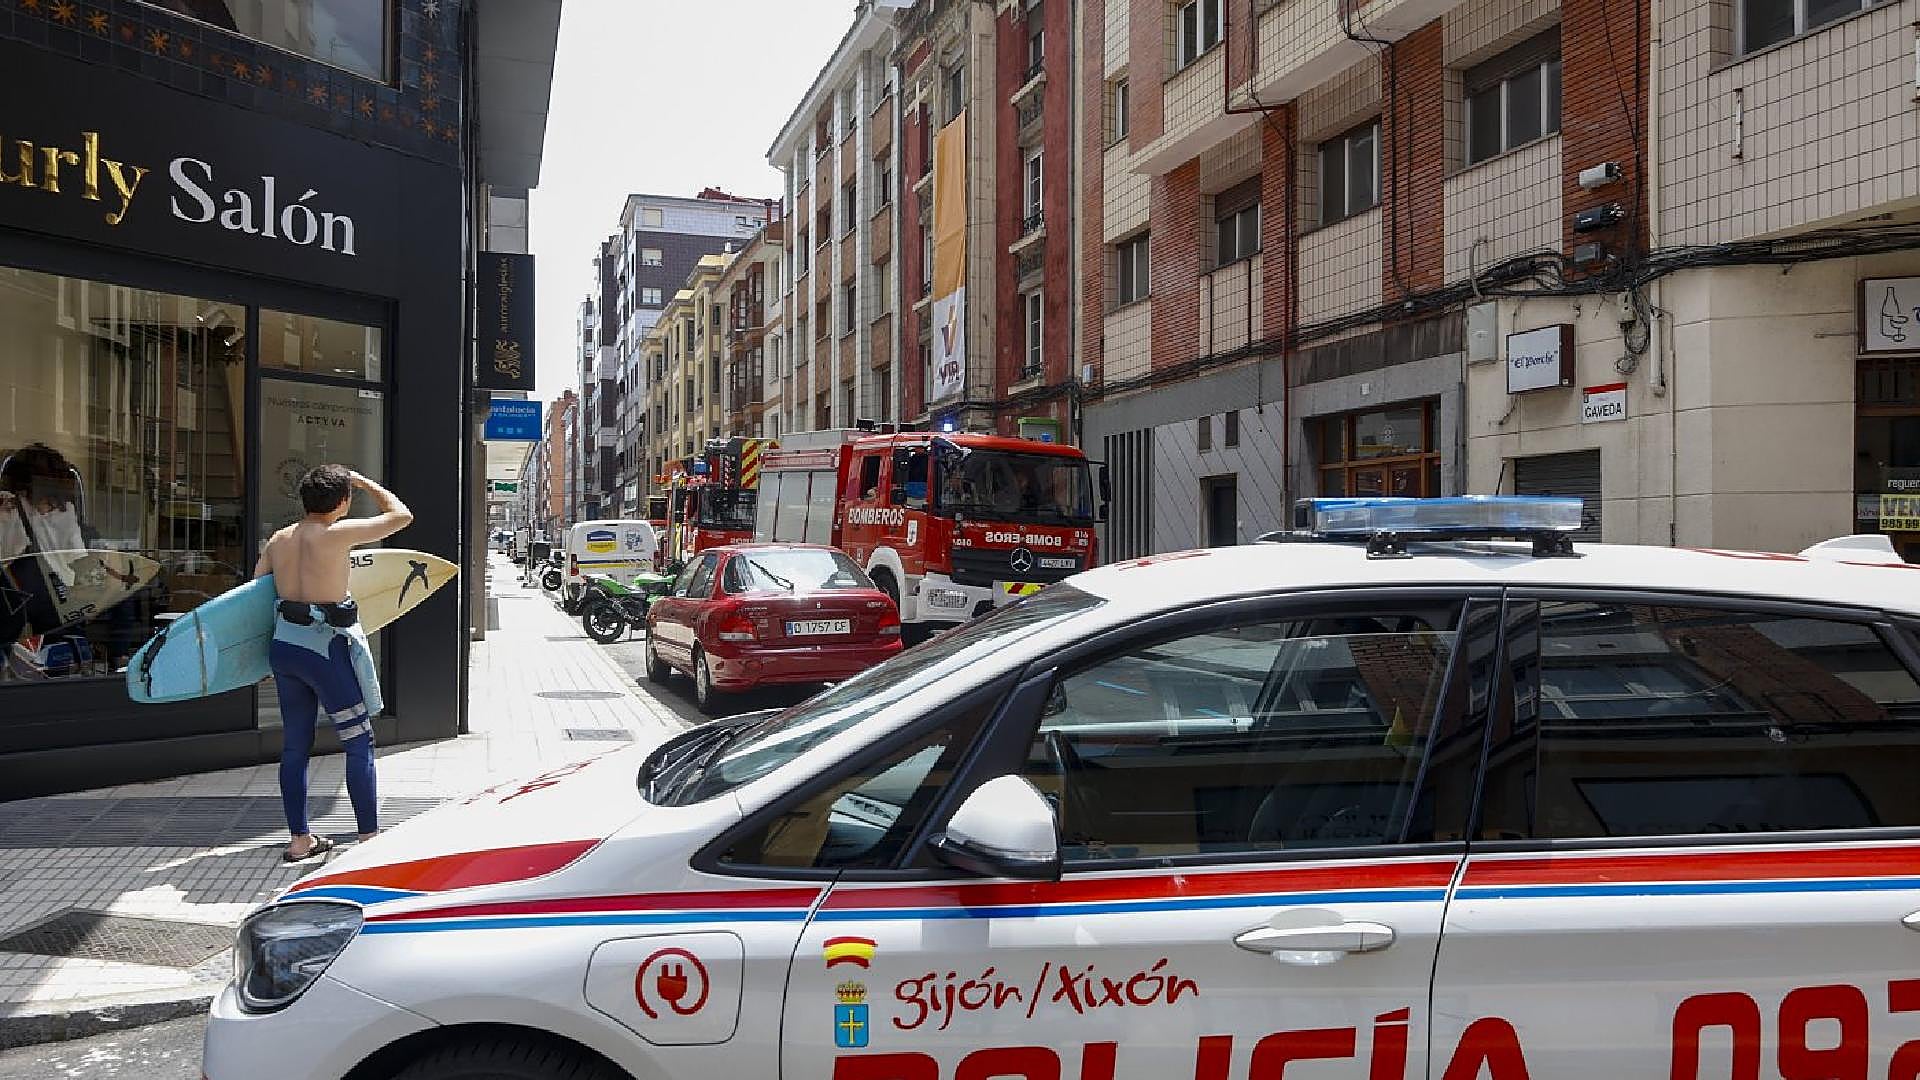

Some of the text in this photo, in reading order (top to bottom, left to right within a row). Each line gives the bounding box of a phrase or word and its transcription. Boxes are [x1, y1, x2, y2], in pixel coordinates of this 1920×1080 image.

[169, 157, 356, 256] Salón
[1585, 402, 1622, 418] CAVEDA
[848, 508, 905, 526] BOMBEROS
